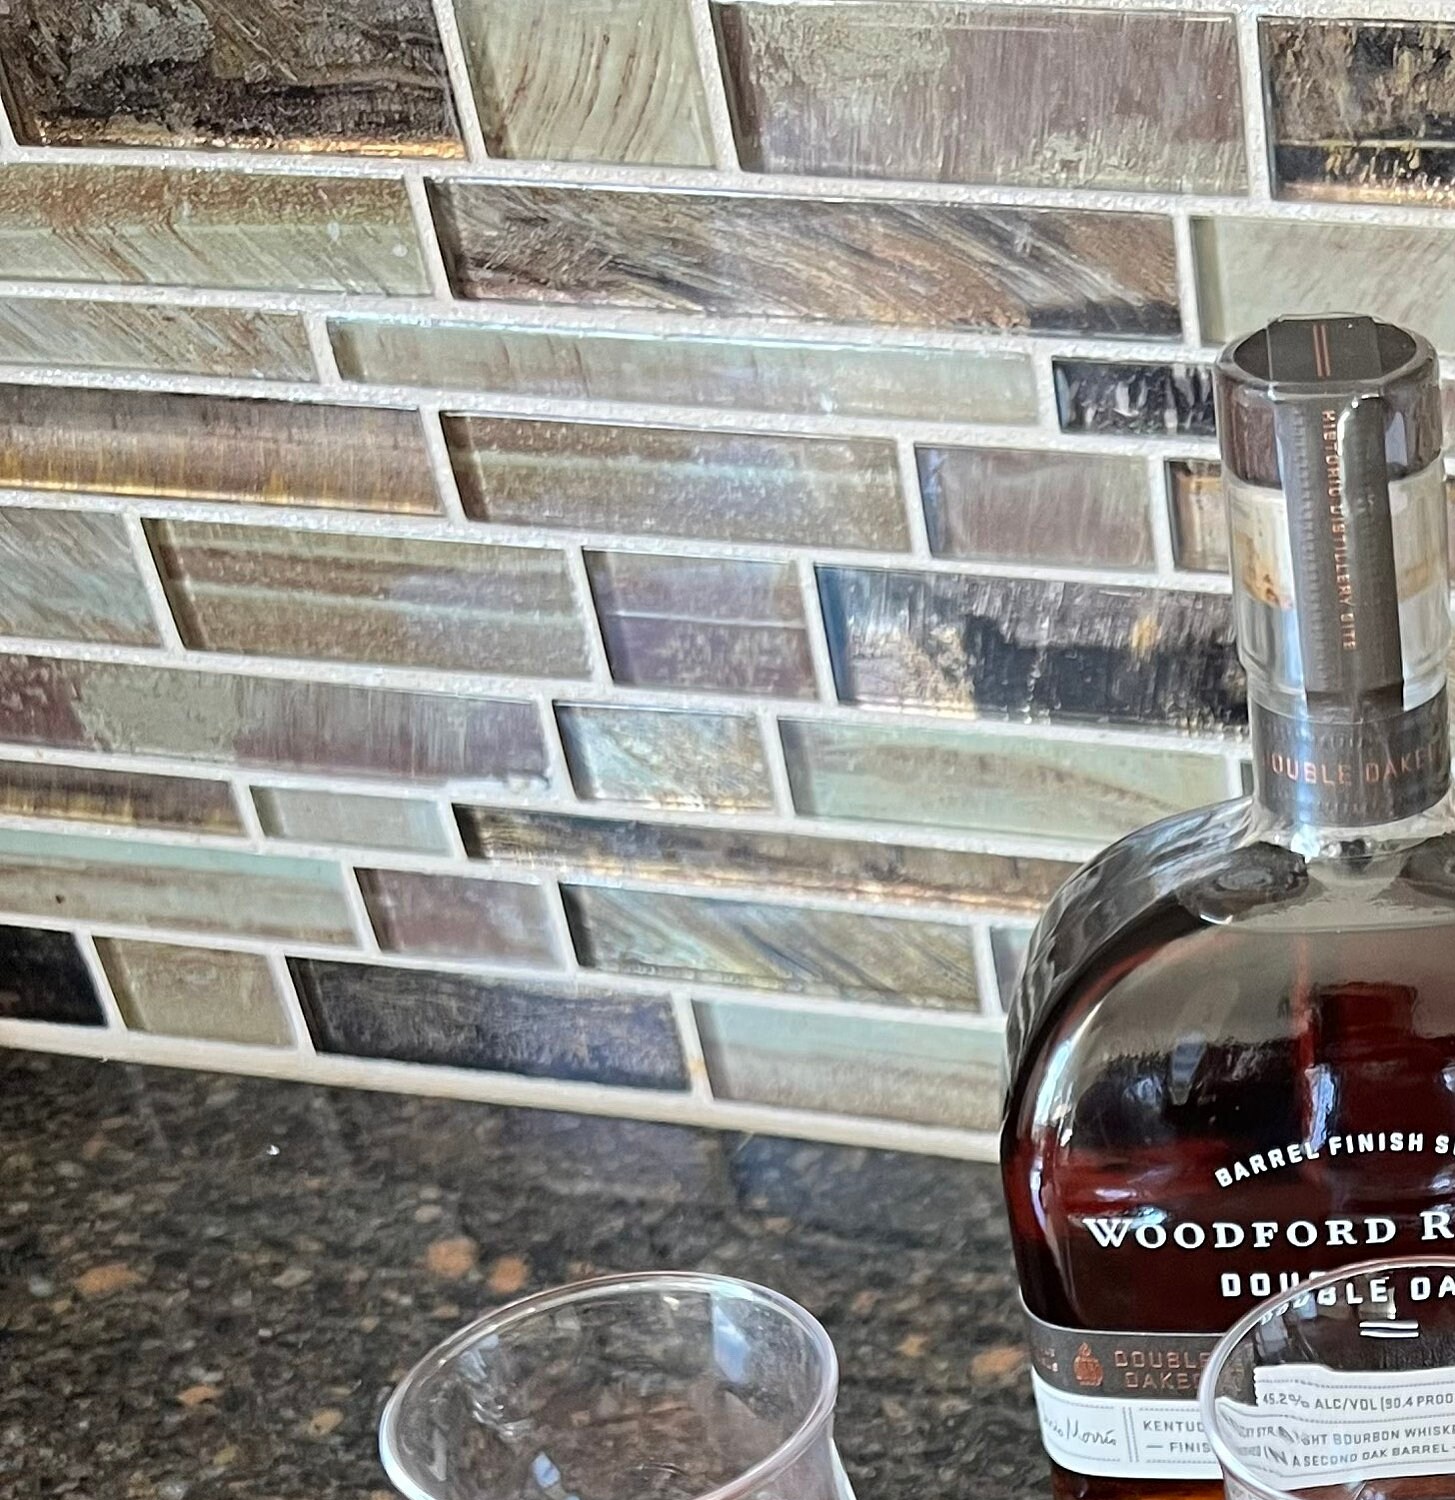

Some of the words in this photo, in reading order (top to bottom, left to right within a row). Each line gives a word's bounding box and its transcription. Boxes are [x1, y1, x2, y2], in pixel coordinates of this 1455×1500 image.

[1330, 503, 1353, 606] DISTILLERY
[1340, 613, 1357, 650] SITE
[1214, 1142, 1321, 1188] BARREL
[1329, 1132, 1424, 1157] FINISH
[1082, 1217, 1397, 1249] WOODFORD
[1315, 1397, 1377, 1411] ALC/VOL
[1332, 1430, 1400, 1445] BOURBON
[1303, 1452, 1358, 1468] SECOND
[1362, 1449, 1388, 1461] OAK
[1392, 1442, 1449, 1458] BARREL
